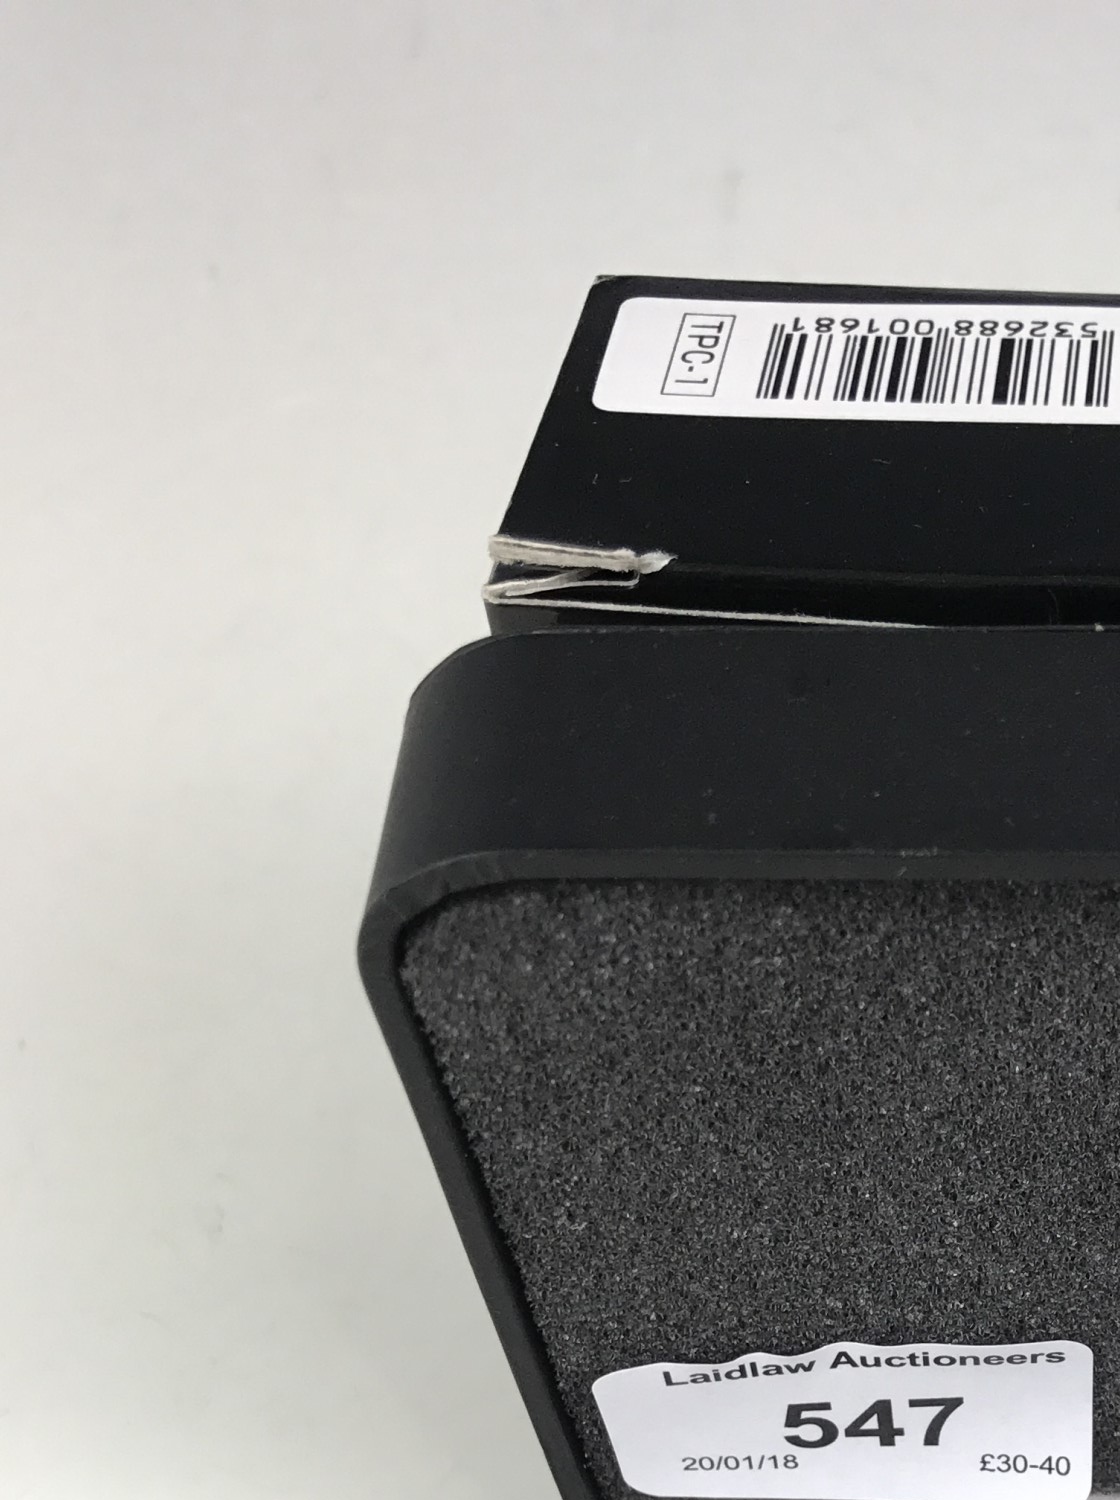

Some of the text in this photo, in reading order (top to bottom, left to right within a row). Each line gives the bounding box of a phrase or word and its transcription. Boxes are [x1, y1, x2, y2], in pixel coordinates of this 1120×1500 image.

[792, 316, 935, 336] 001681
[954, 319, 1098, 338] 532688
[674, 321, 724, 385] TPC-1
[662, 1350, 1067, 1388] Laidlaw Auctioneers
[783, 1396, 964, 1450] 547
[681, 1453, 1072, 1477] 20/01/18 £30-40
